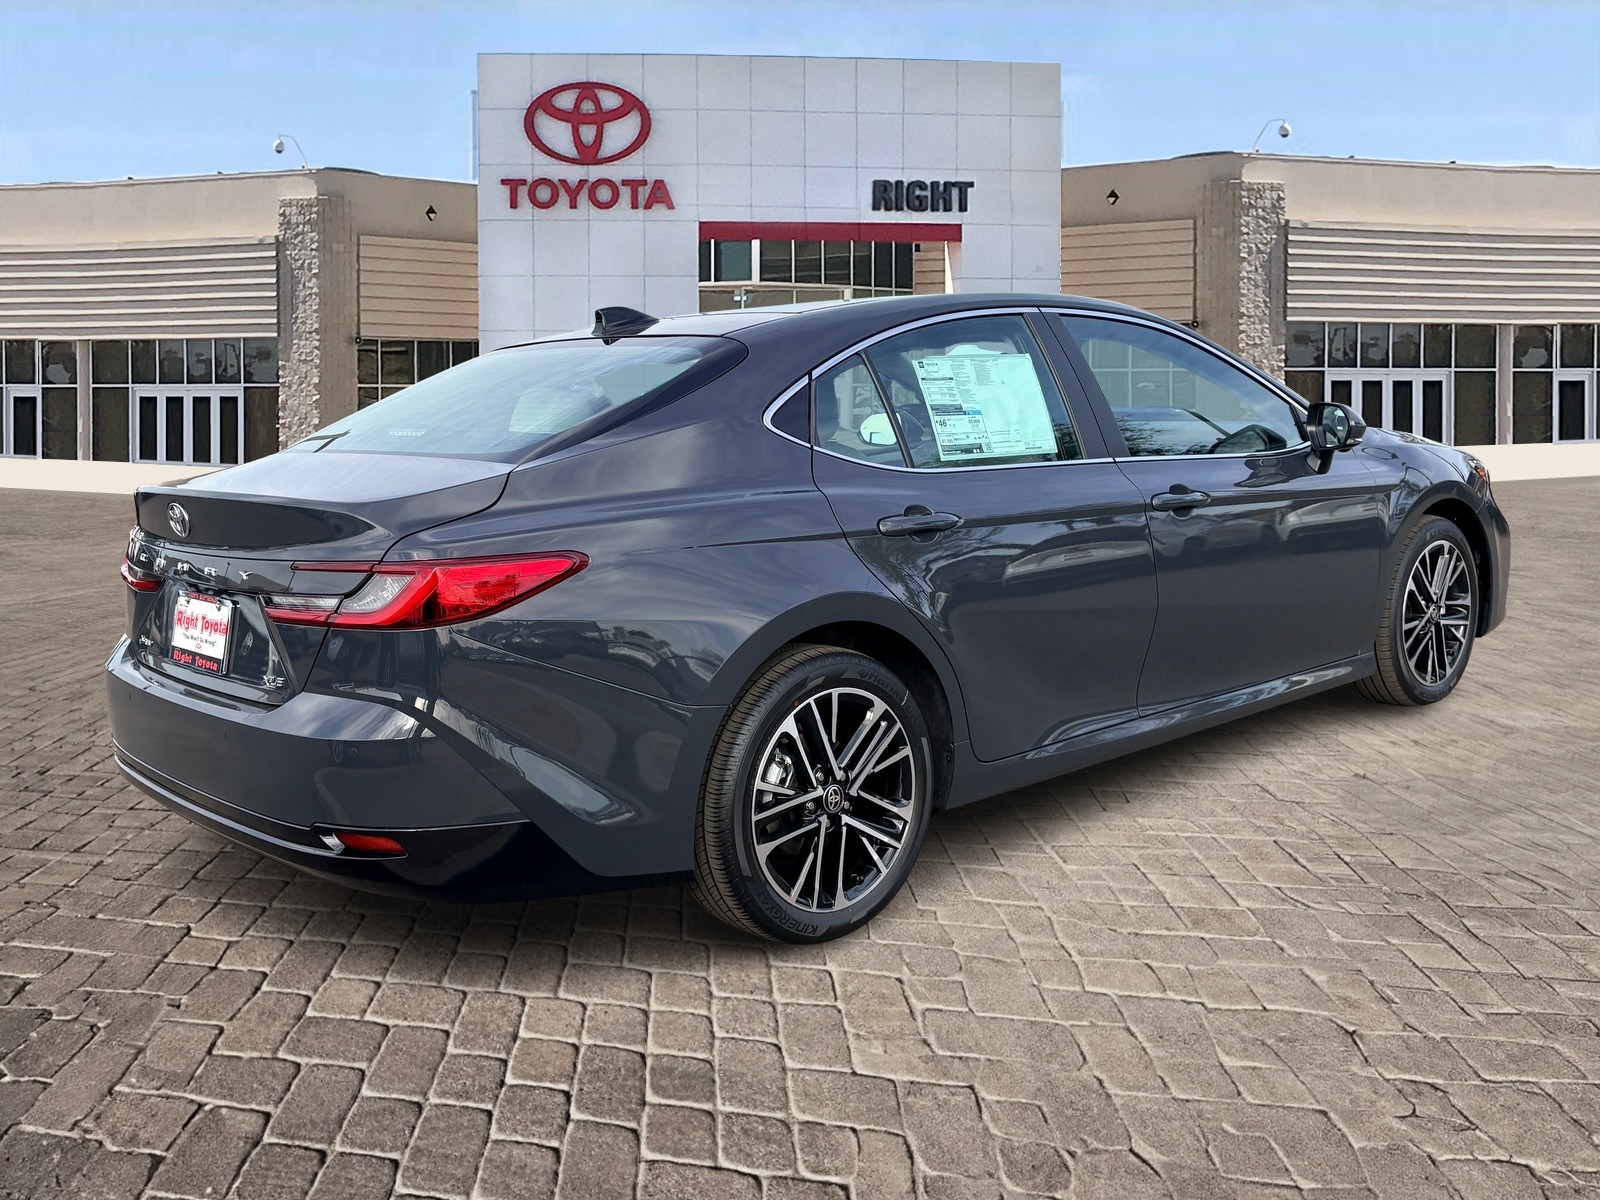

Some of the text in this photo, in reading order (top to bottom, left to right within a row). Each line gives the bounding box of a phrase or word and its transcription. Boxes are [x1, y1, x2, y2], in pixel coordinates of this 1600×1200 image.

[501, 177, 675, 210] TOYOTA
[870, 179, 975, 213] RIGHT
[175, 609, 229, 636] Right Toyota
[173, 649, 218, 671] Right Toyota
[765, 906, 819, 935] KINERGY
